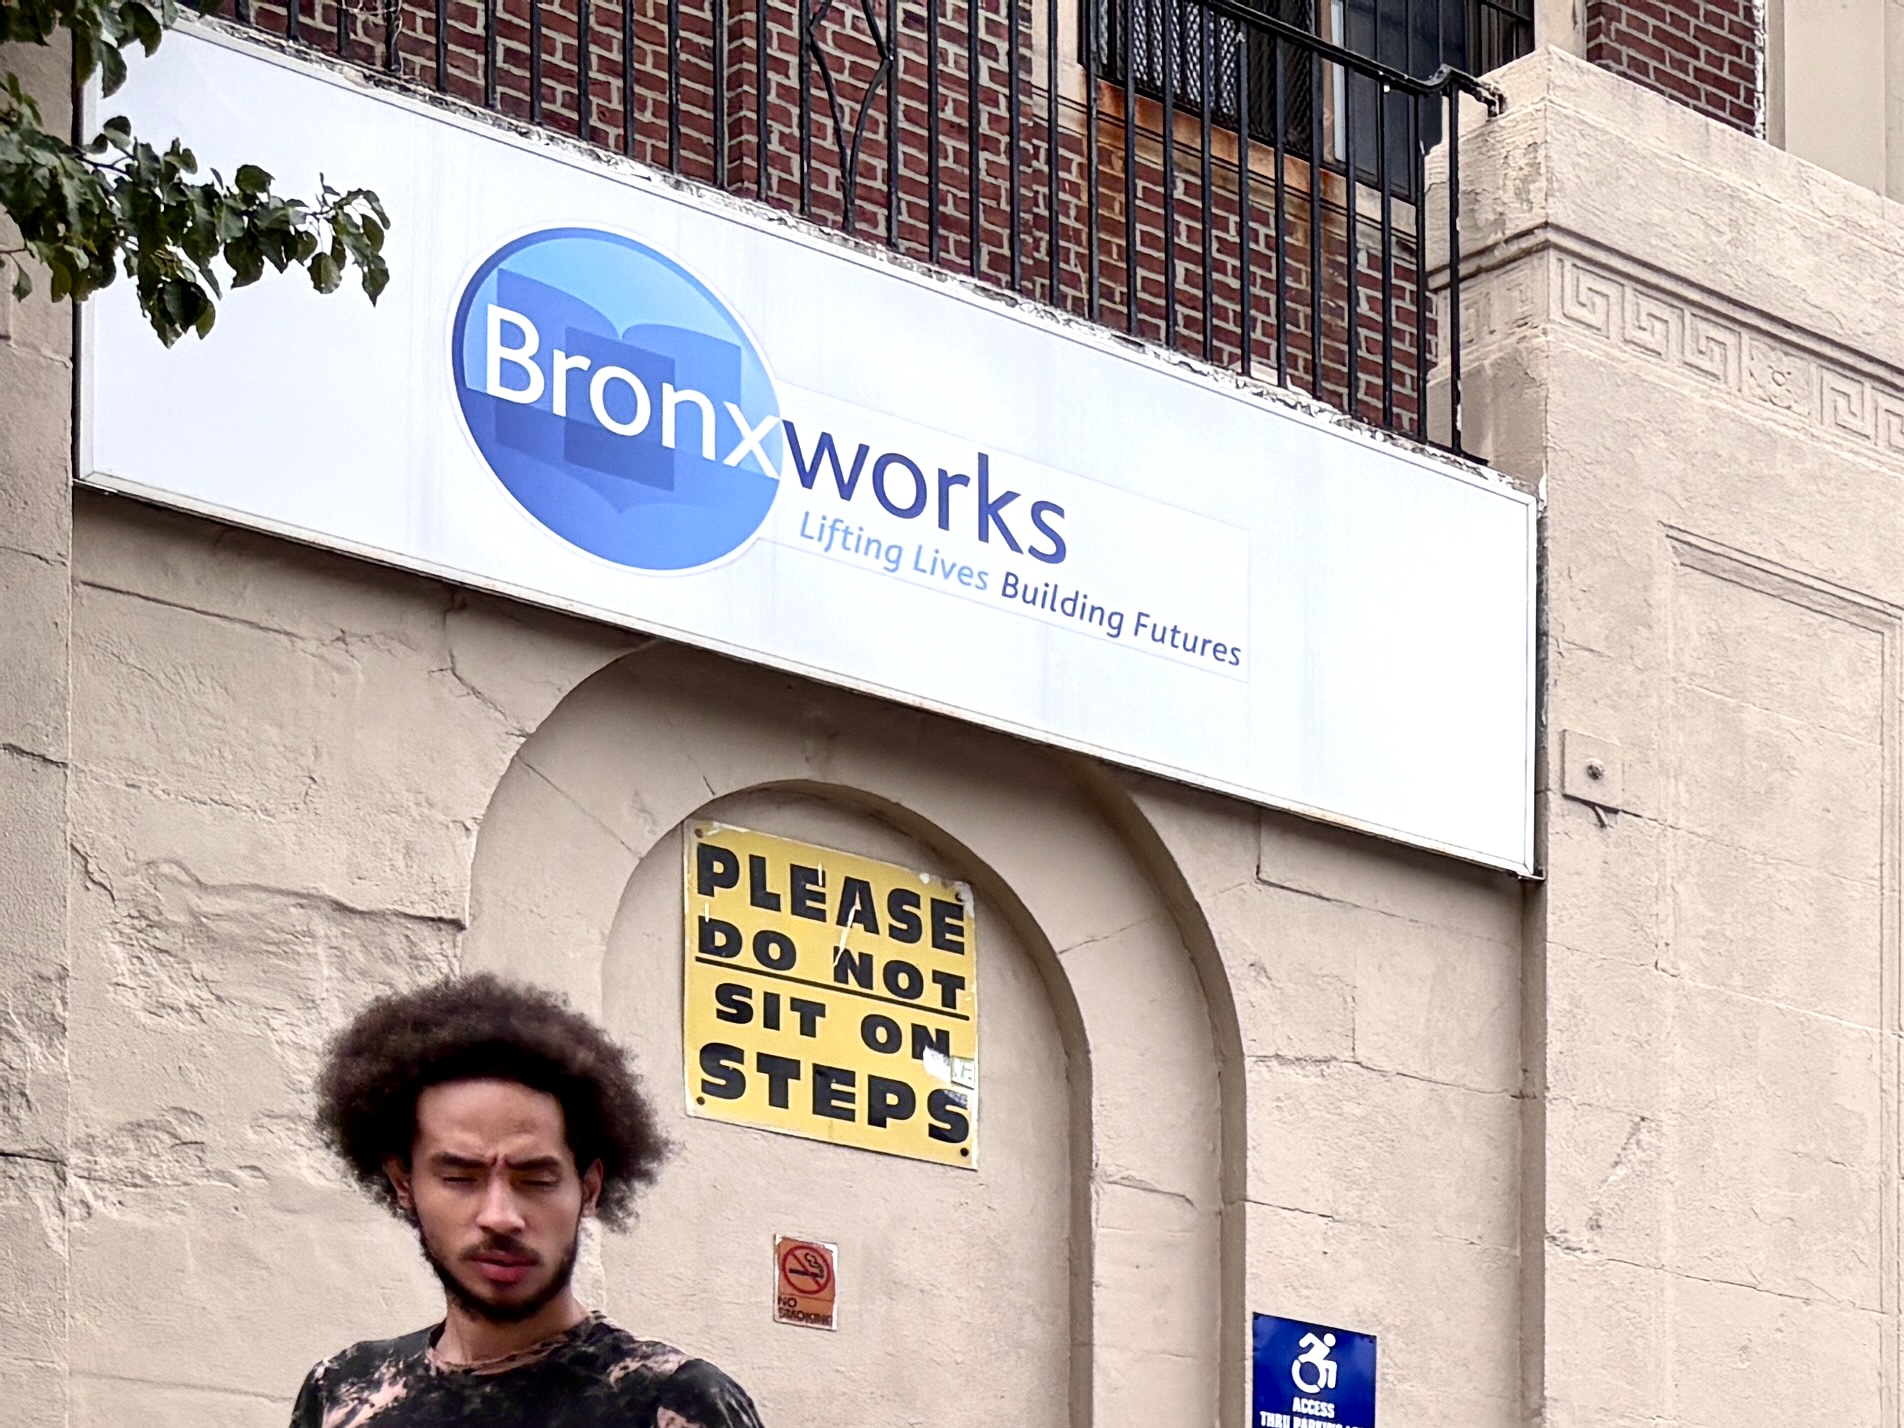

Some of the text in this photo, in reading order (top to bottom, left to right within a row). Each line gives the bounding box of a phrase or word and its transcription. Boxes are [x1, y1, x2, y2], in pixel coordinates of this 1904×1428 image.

[482, 303, 1067, 564] Bronxworks
[799, 510, 1242, 667] Lifting Lives Building Futures
[697, 842, 965, 956] PLEASE
[698, 915, 965, 1010] DO NOT
[715, 983, 950, 1060] SIT ON
[699, 1042, 970, 1143] STEPS
[1292, 1397, 1335, 1418] ACCESS
